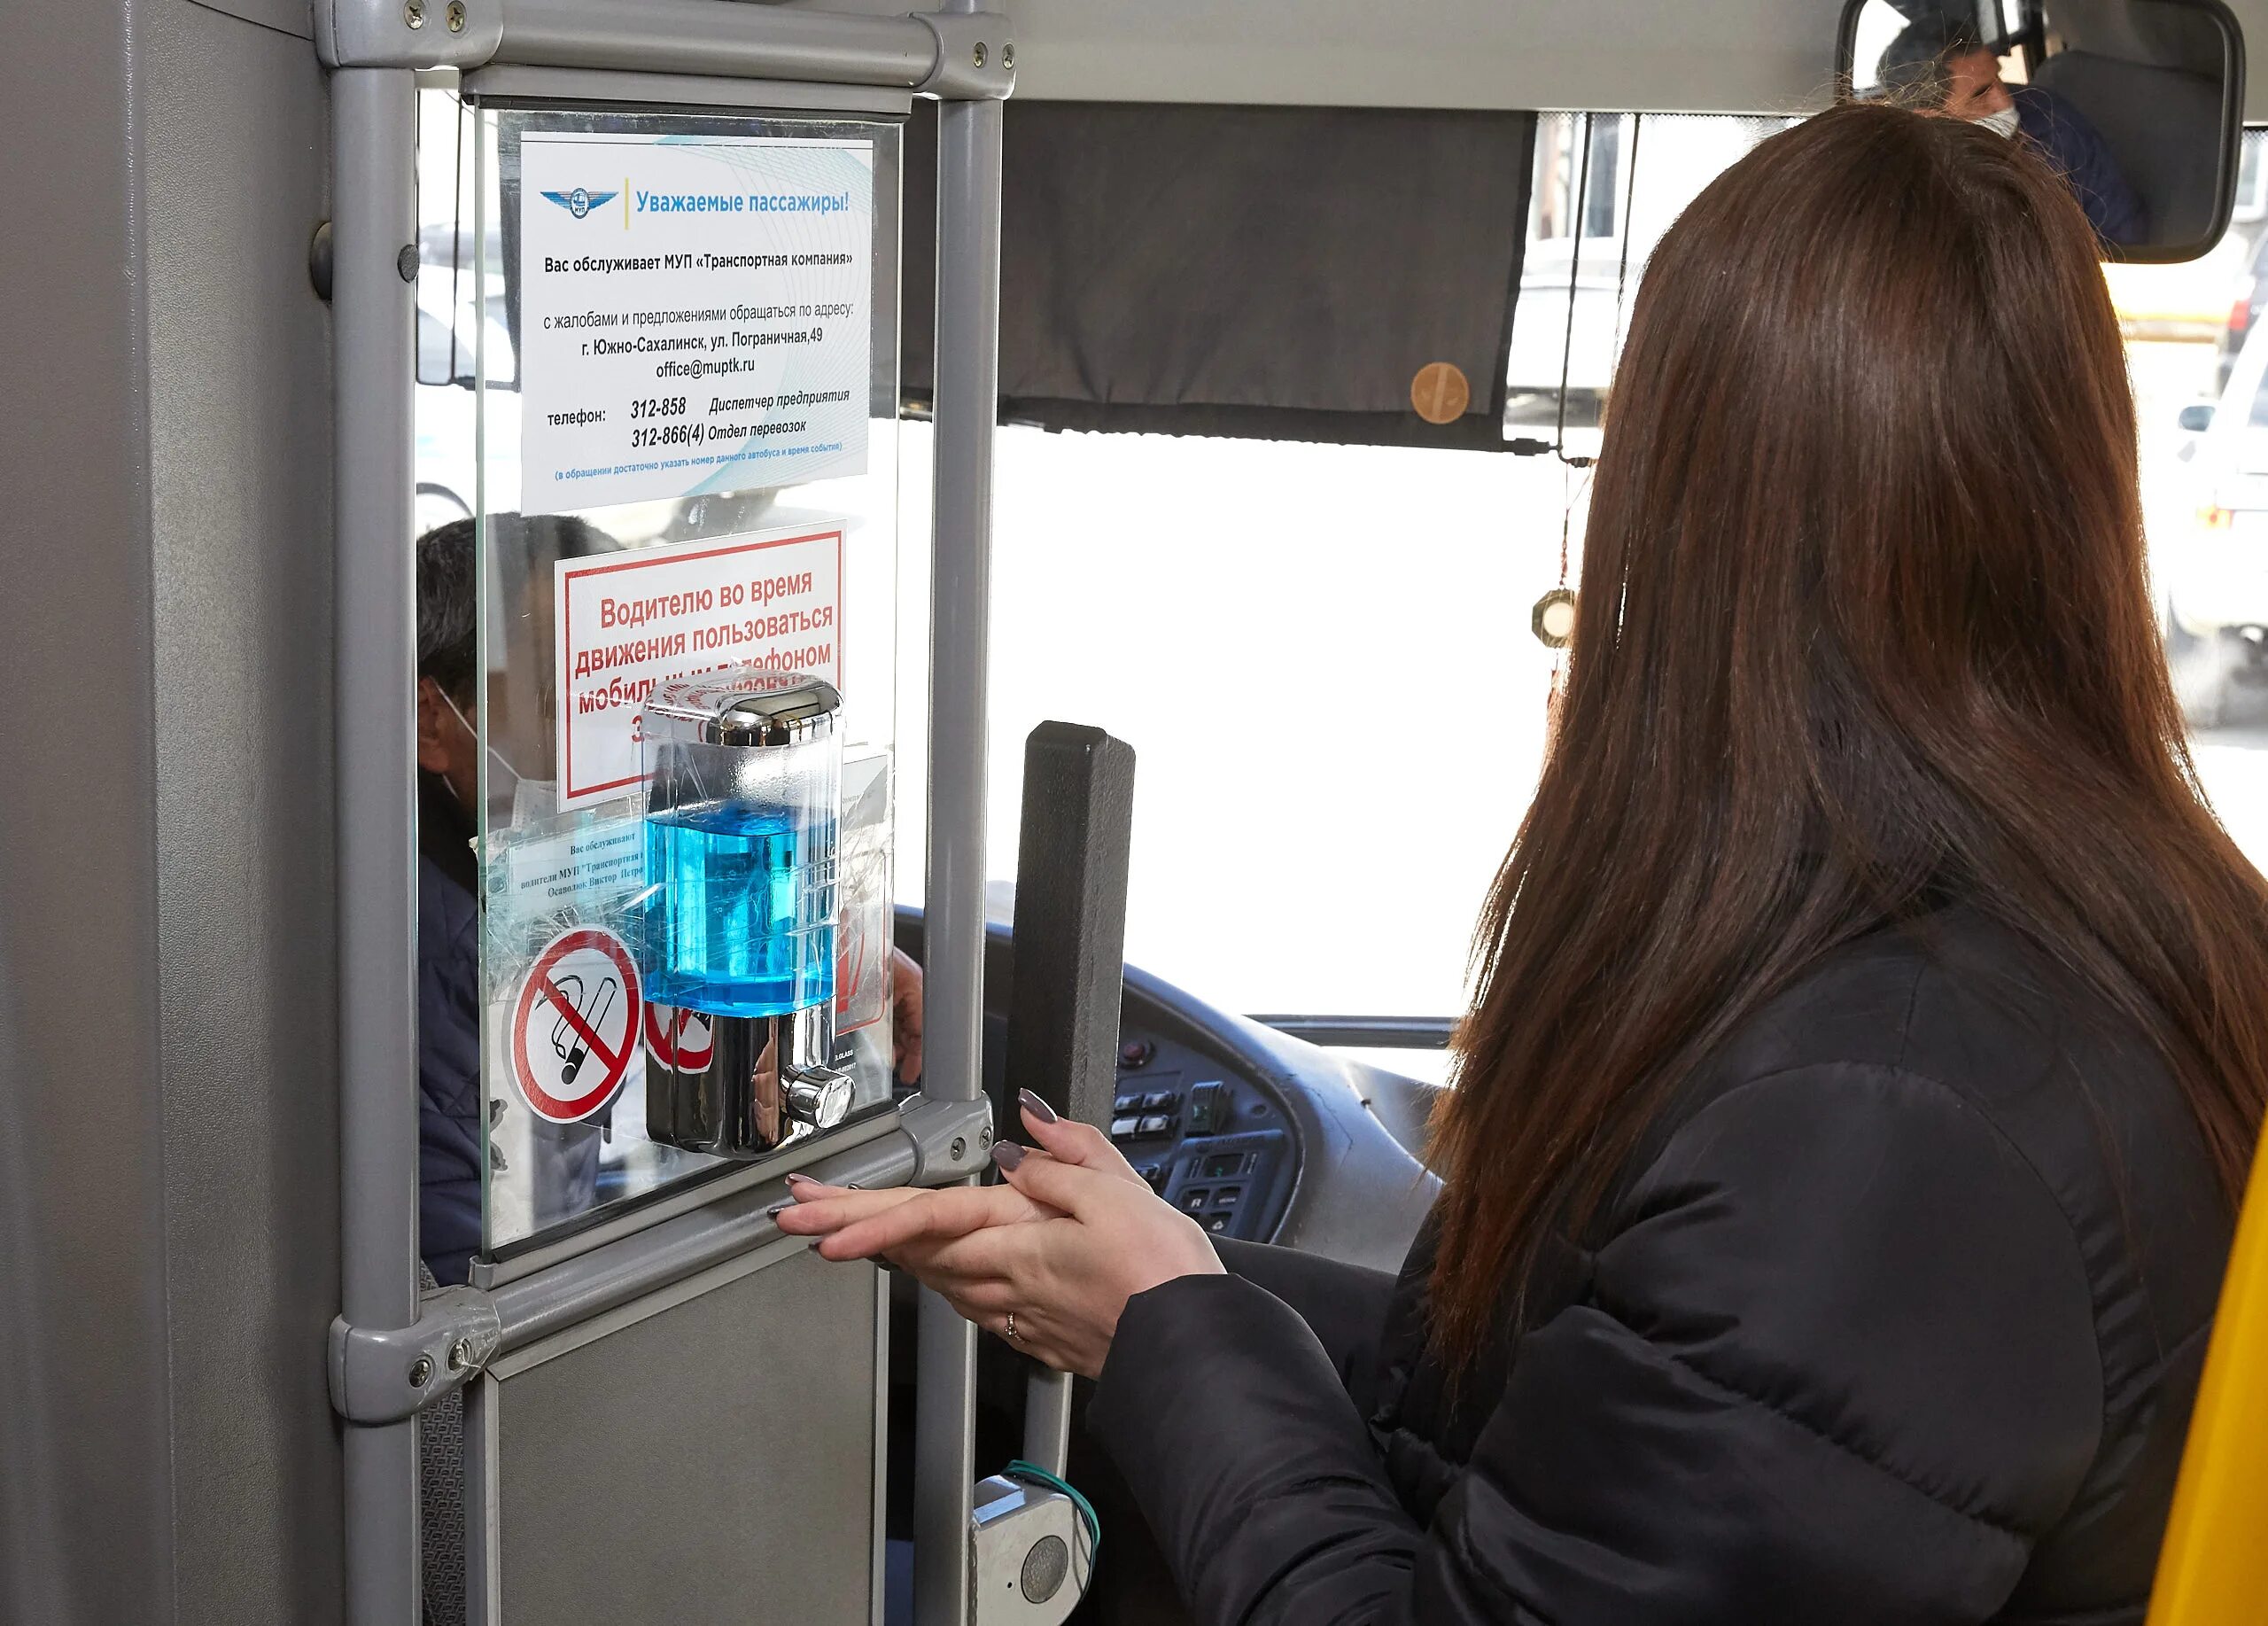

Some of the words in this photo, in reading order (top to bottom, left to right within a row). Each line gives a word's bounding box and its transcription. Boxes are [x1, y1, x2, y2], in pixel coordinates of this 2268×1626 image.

[636, 191, 743, 213] Уважаемые
[749, 191, 850, 216] пассажиры!
[544, 257, 569, 273] Вас
[572, 255, 661, 274] обслуживает
[664, 254, 693, 269] МУП
[695, 253, 788, 271] «Транспортная
[791, 253, 853, 267] компания»
[543, 317, 551, 330] с
[554, 311, 618, 329] жалобами
[622, 315, 629, 326] и
[633, 307, 726, 329] предложениями
[730, 305, 796, 322] обращаться
[799, 305, 812, 319] по
[814, 302, 854, 319] адресу:
[581, 344, 589, 356] г.
[593, 335, 708, 355] Южно-Сахалинск,
[711, 335, 728, 352] ул.
[732, 329, 823, 347] Пограничная,49
[656, 357, 755, 379] office@muptk.ru
[547, 408, 606, 427] телефон:
[630, 396, 687, 420] 312-858
[708, 397, 774, 416] Диспетчер
[776, 388, 850, 408] предприятия
[632, 422, 704, 448] 312-866(4)
[708, 424, 747, 441] Отдел
[750, 418, 807, 440] перевозок
[555, 471, 563, 481] (в
[565, 466, 612, 479] обращении
[613, 461, 659, 475] достаточно
[660, 457, 689, 471] указать
[691, 455, 715, 466] номер
[717, 453, 746, 464] данного
[748, 448, 781, 461] автобуса
[788, 445, 810, 457] время
[811, 441, 843, 453] события)
[600, 588, 713, 630] Водителю
[719, 583, 744, 609] во
[750, 571, 812, 608] время
[574, 632, 686, 679] движения
[692, 605, 834, 652] пользоваться
[570, 844, 585, 856] Вас
[585, 832, 636, 852] обслуживают
[520, 874, 558, 890] водители
[558, 866, 580, 881] МУП
[581, 854, 639, 873] "Транспортная
[589, 872, 617, 887] Виктор
[620, 865, 644, 879] Петро
